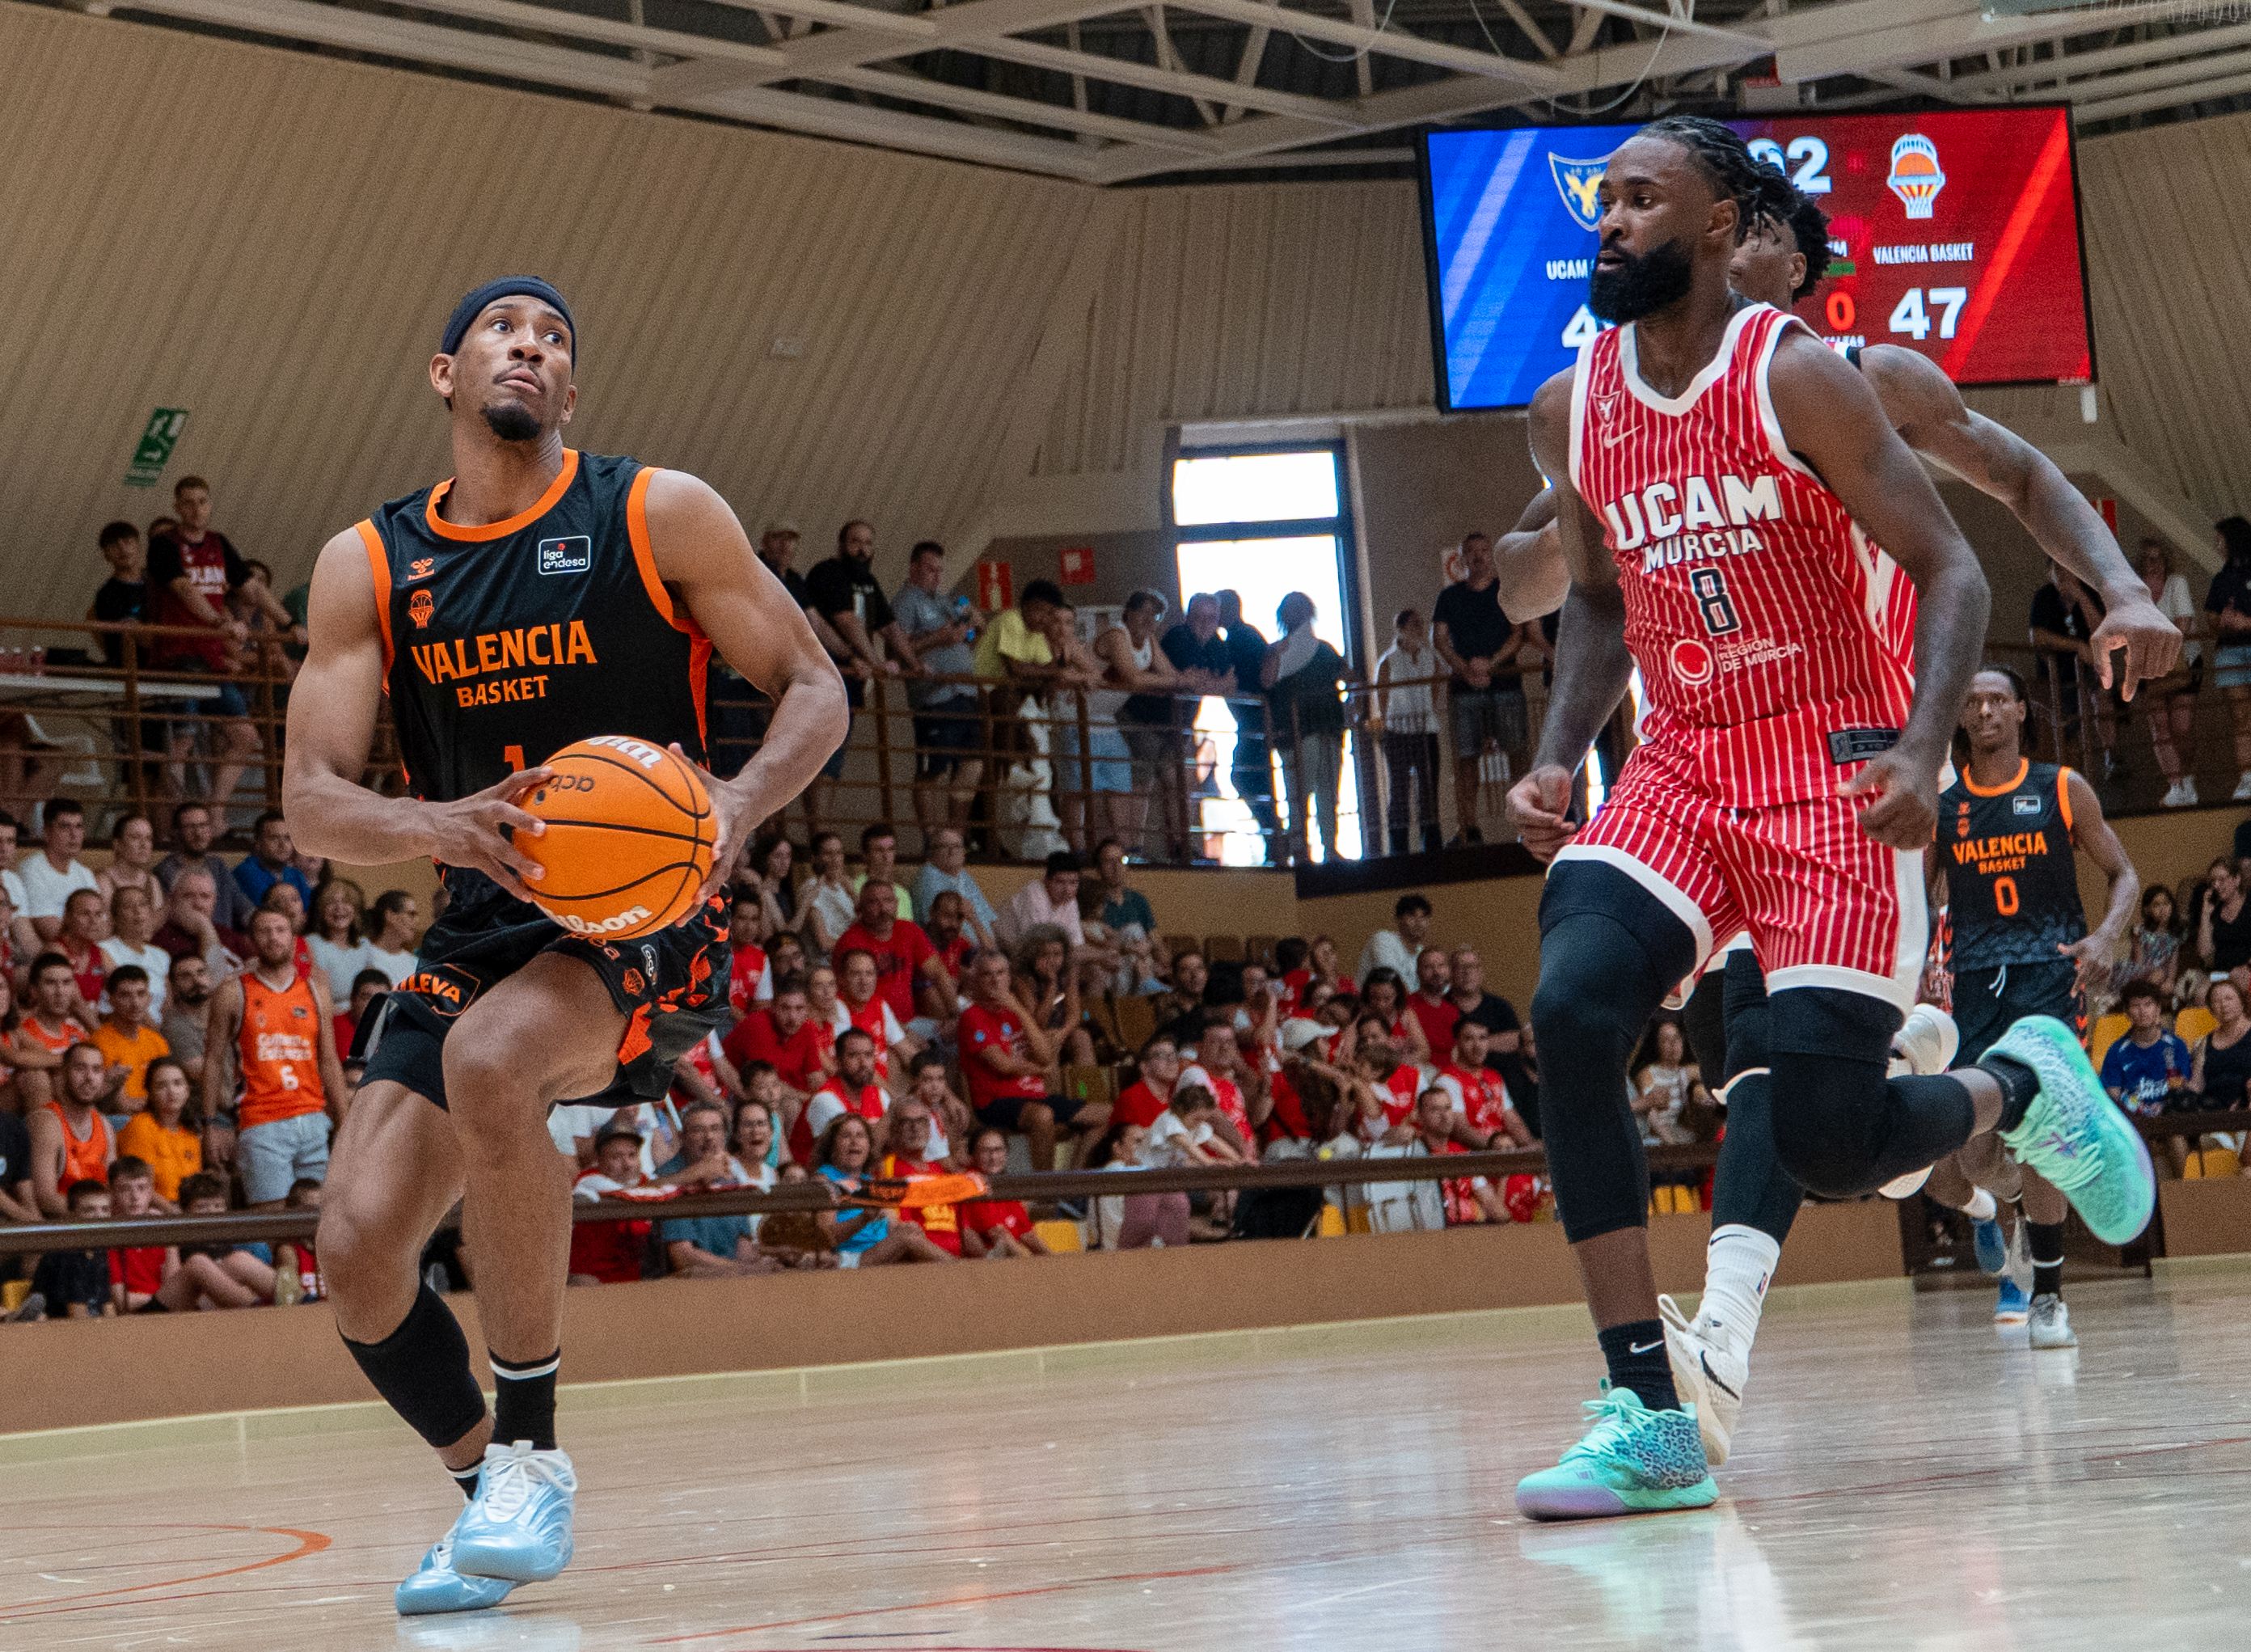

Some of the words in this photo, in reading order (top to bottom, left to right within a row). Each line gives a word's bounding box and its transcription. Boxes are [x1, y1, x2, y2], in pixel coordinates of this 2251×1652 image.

[1546, 259, 1589, 281] UCAM
[1873, 245, 1928, 264] VALENCIA
[1930, 243, 1974, 262] BASKET
[1561, 303, 1616, 348] 4
[1826, 291, 1856, 331] 0
[1889, 287, 1967, 340] 47
[1604, 474, 1782, 551] UCAM
[543, 550, 564, 560] liga
[543, 558, 586, 569] endesa
[1644, 527, 1765, 575] MURCIA
[1691, 567, 1742, 636] 8
[411, 619, 598, 685] VALENCIA
[1722, 657, 1743, 673] DE
[1744, 642, 1802, 666] MURCIA
[456, 674, 550, 708] BASKET
[1952, 830, 2049, 865] VALENCIA
[1977, 855, 2027, 876] BASKET
[1993, 875, 2020, 917] 0
[392, 973, 461, 1004] LEVA
